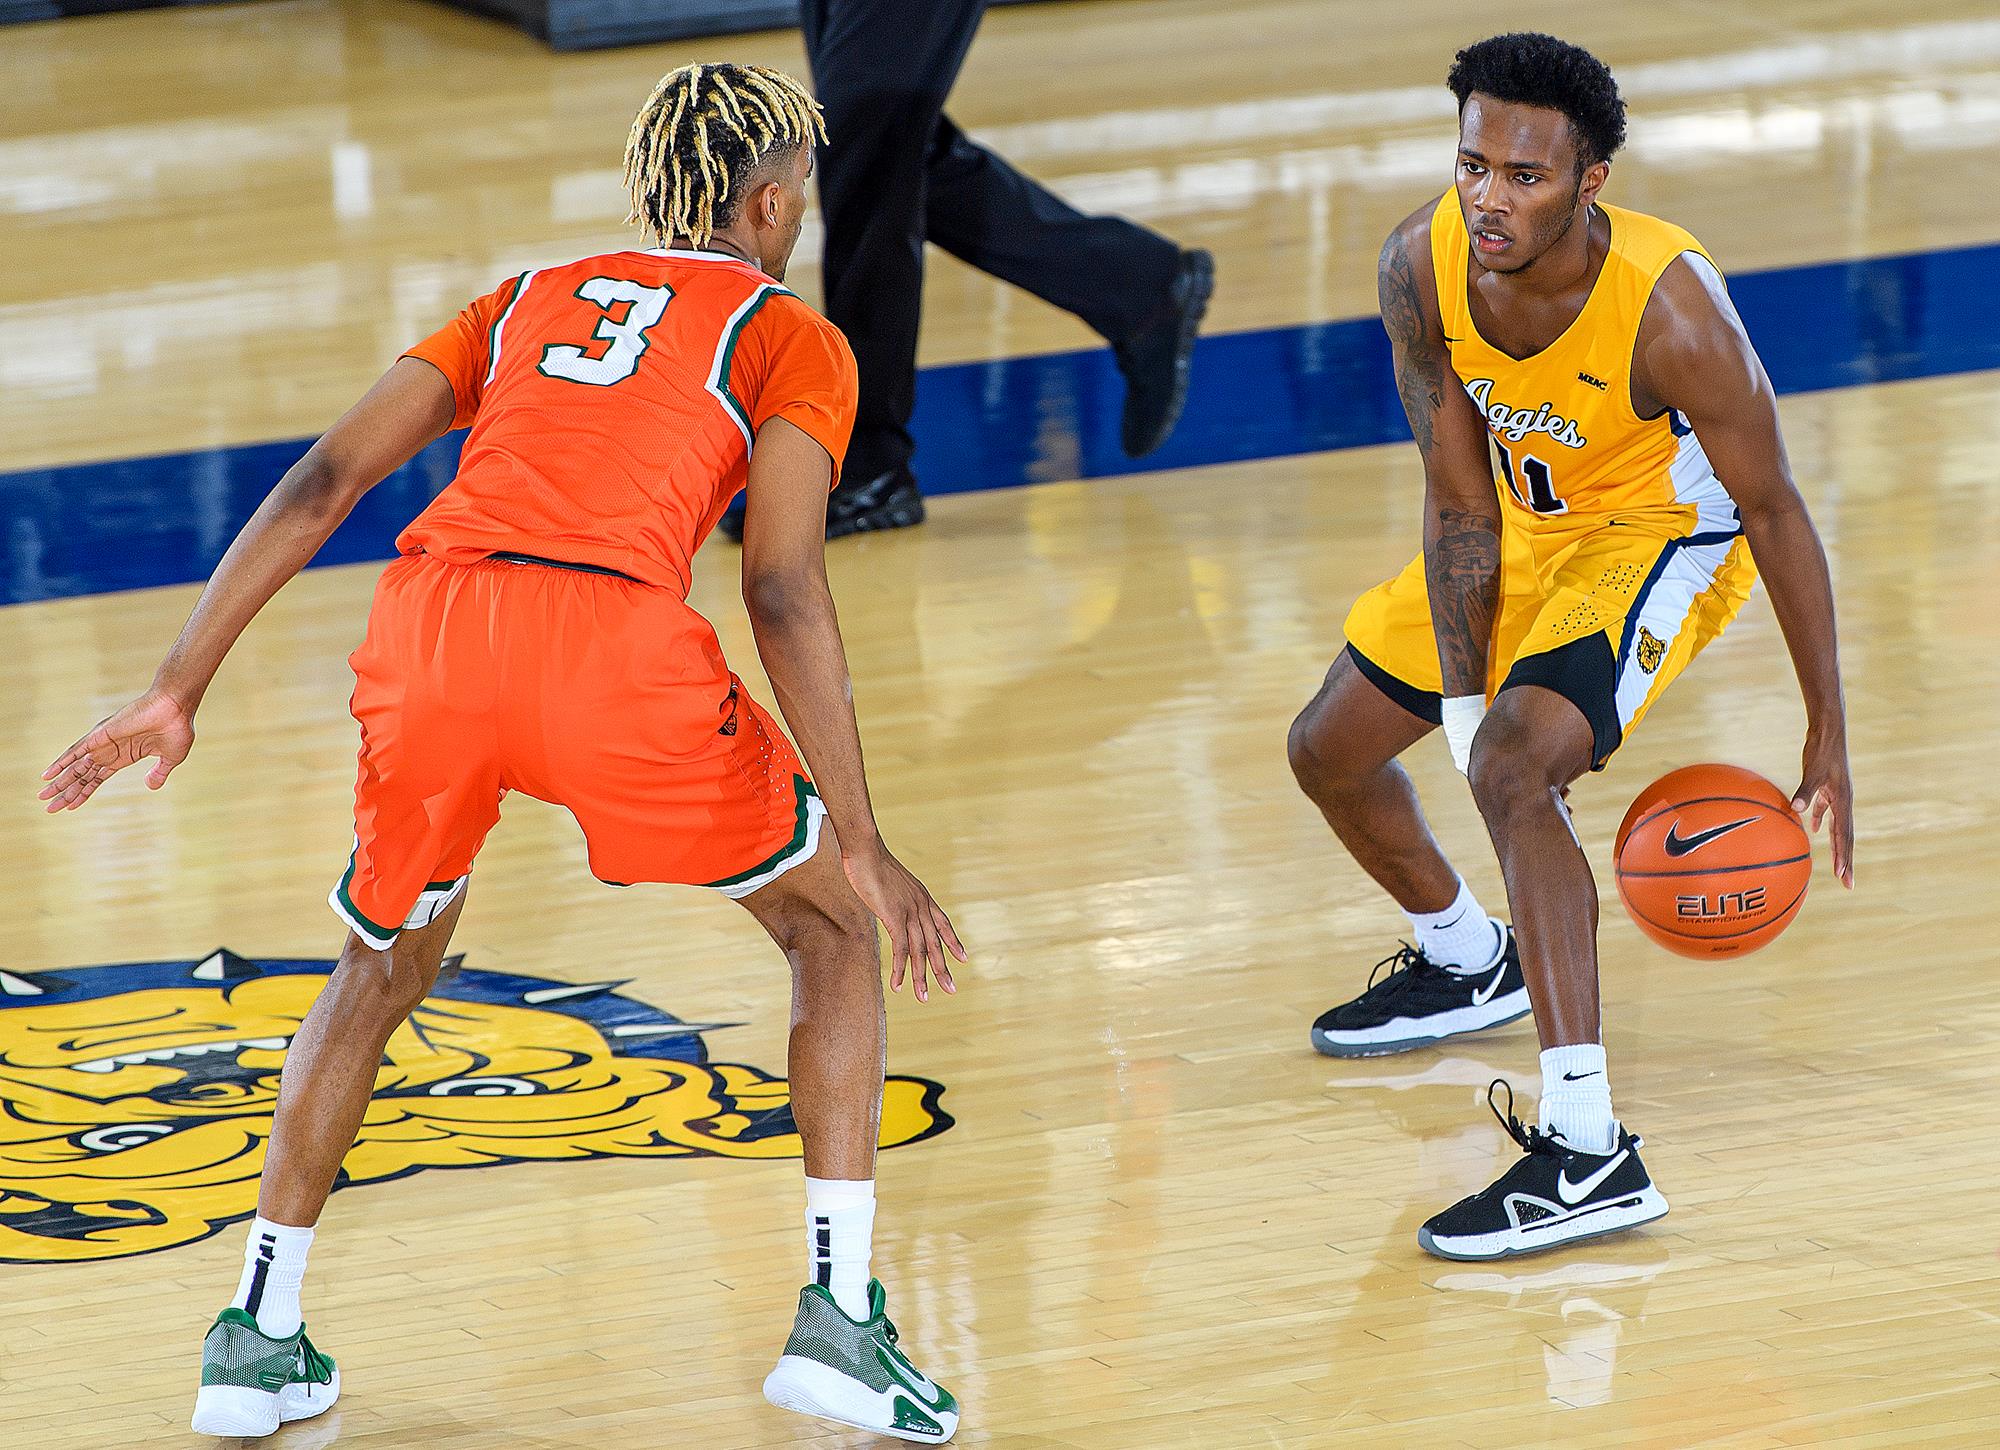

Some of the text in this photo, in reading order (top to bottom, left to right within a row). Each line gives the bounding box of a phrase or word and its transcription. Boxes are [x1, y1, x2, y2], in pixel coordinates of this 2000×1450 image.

[536, 276, 677, 387] 3
[1463, 378, 1587, 448] Aggies
[1676, 886, 1766, 918] ELITE
[1677, 909, 1767, 924] CHAMPIONSHIP
